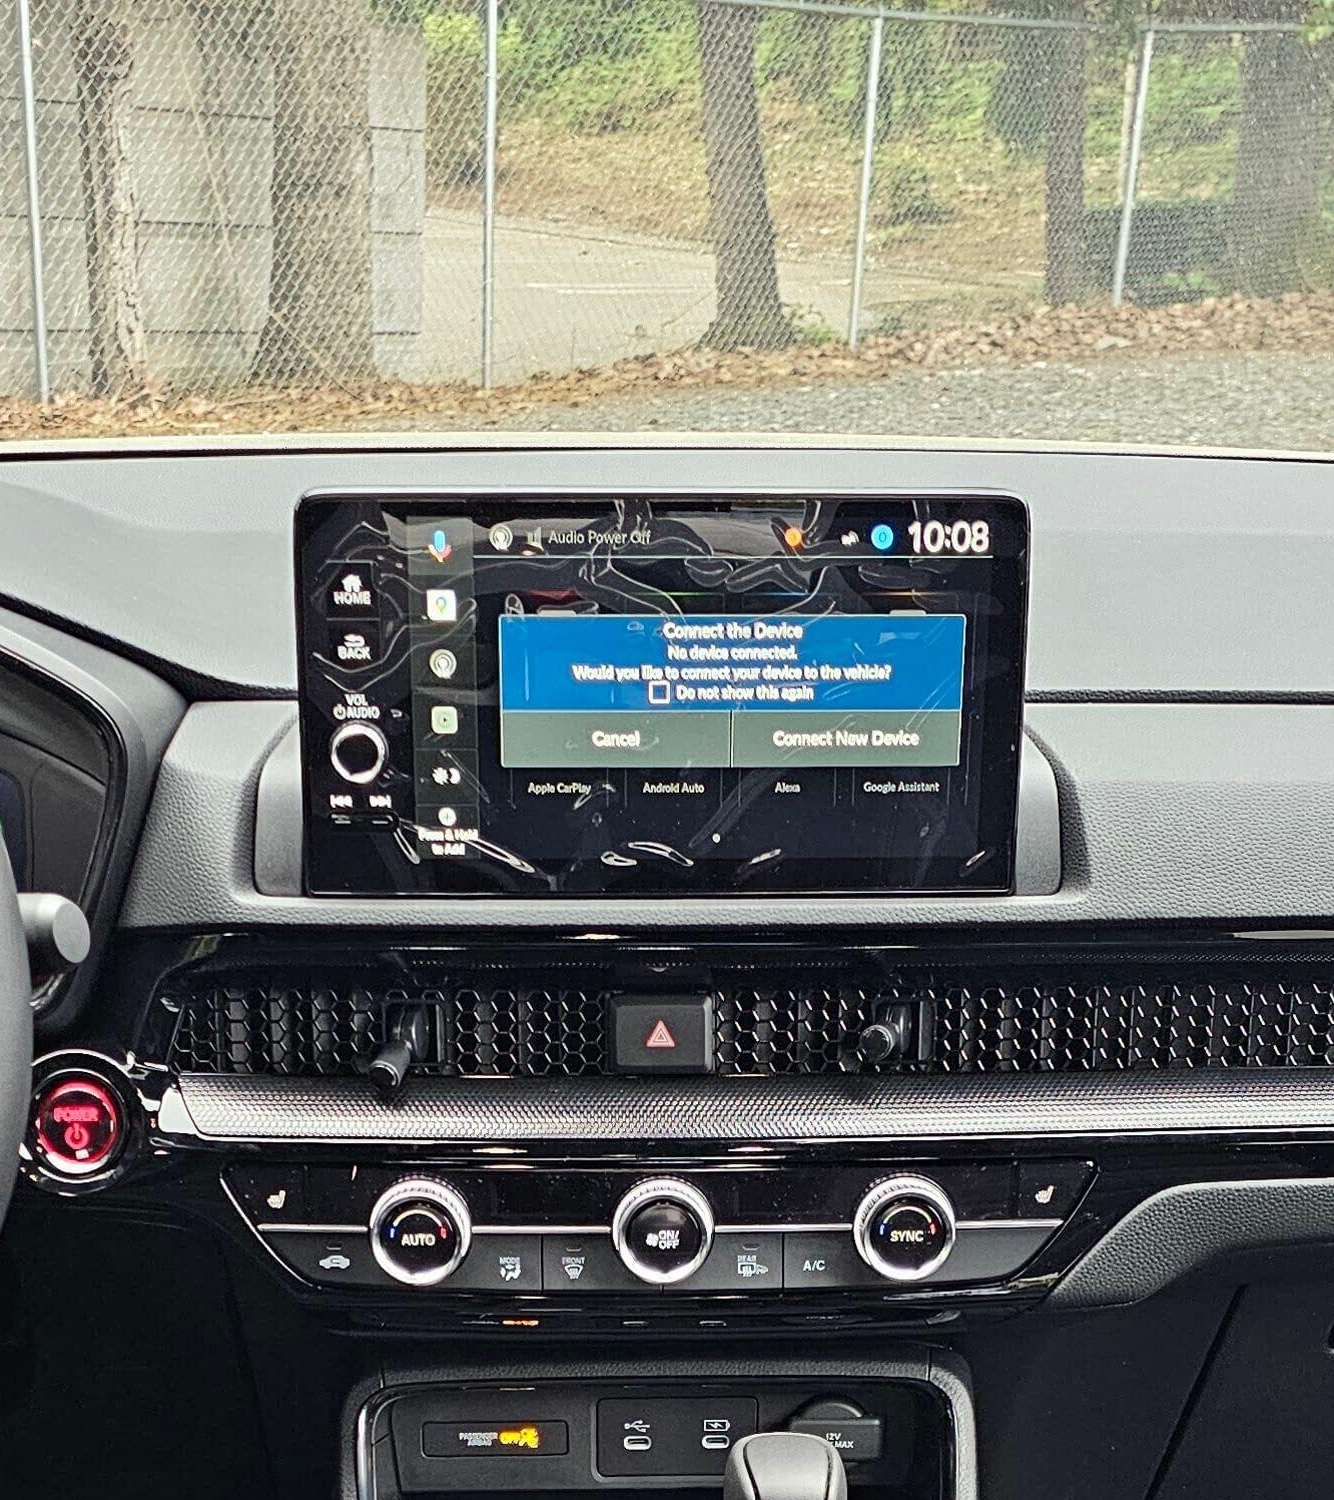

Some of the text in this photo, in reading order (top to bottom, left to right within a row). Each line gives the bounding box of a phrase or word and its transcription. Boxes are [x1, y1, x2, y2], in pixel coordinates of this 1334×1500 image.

[548, 530, 651, 545] Audio Power Off
[908, 520, 989, 553] 10:08
[333, 591, 371, 605] HOME
[663, 622, 804, 639] Connect the Device
[338, 647, 371, 660] BACK
[667, 644, 798, 660] No device connected.
[572, 664, 891, 683] Would you like to connect your device to the vehicle?
[676, 685, 814, 702] Do not show this again
[345, 694, 368, 707] VOL
[347, 706, 380, 719] AUDIO
[592, 730, 640, 747] Cancel
[773, 730, 919, 747] Connect New Device
[528, 782, 592, 795] Apple CarPlay
[642, 782, 705, 794] Android Auto
[774, 782, 801, 793] Alexa
[863, 781, 940, 794] Google Assistant
[401, 1232, 435, 1247] AUTO
[658, 1230, 680, 1240] ON/
[889, 1230, 925, 1243] SYNC
[658, 1239, 680, 1250] OFF
[499, 1256, 520, 1265] MODE
[562, 1256, 585, 1265] FRONT
[802, 1260, 825, 1272] A/C
[825, 1432, 841, 1441] 12V
[835, 1441, 854, 1449] MAX
